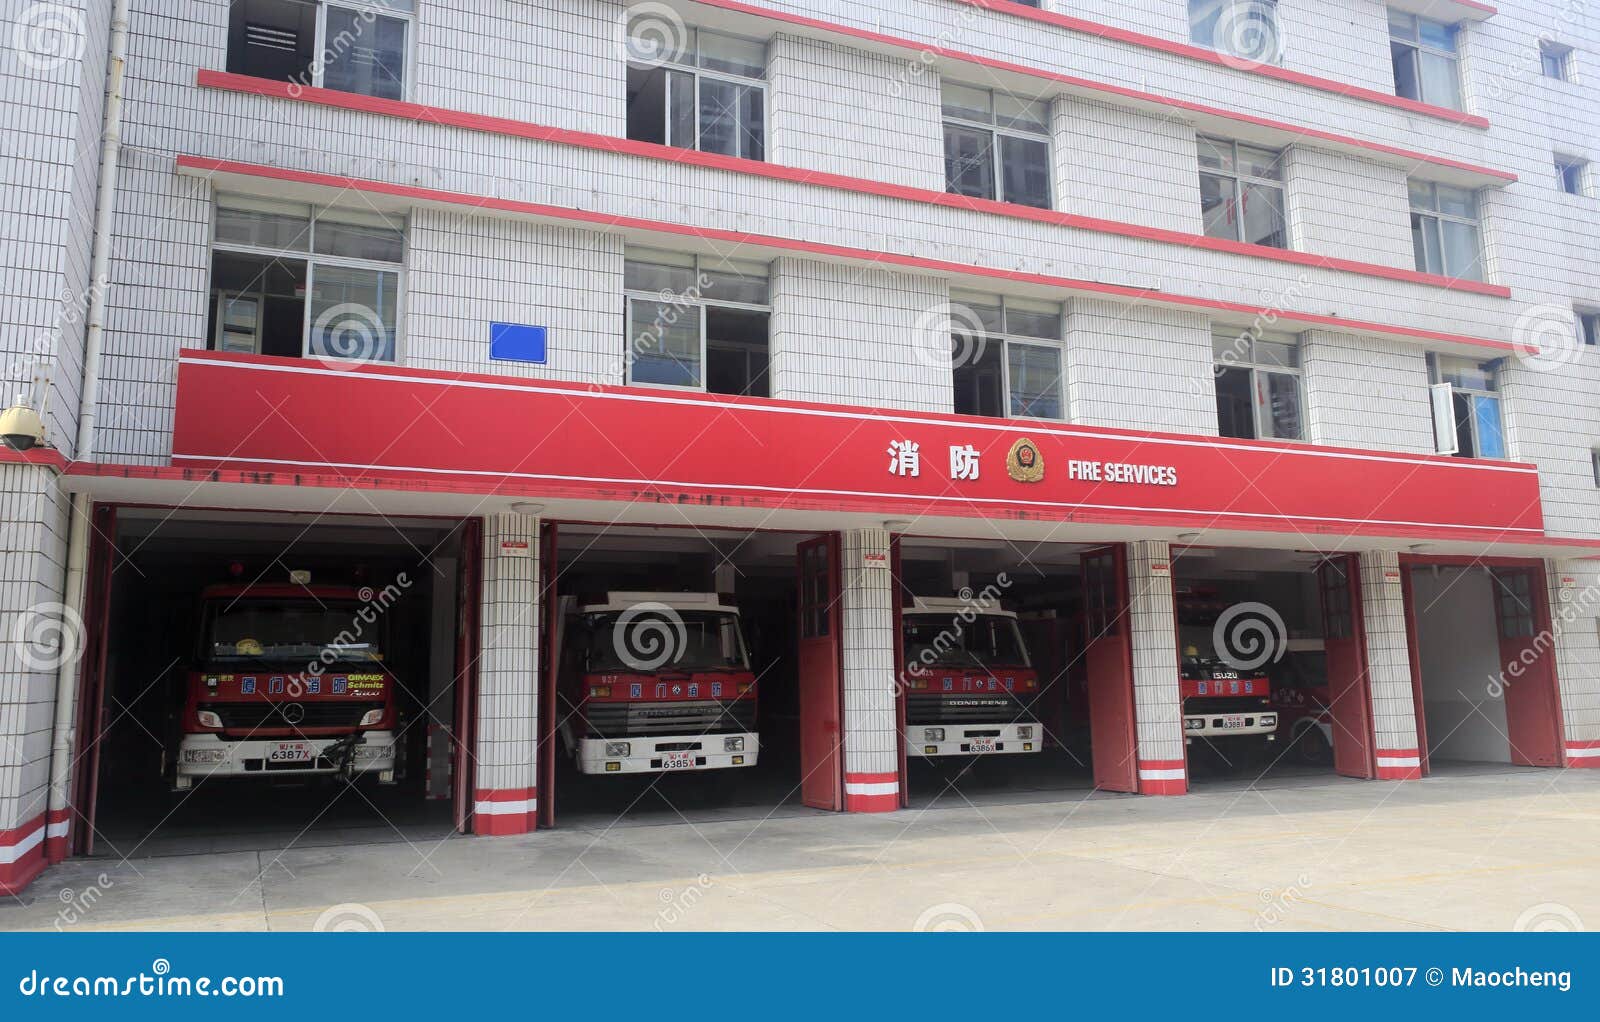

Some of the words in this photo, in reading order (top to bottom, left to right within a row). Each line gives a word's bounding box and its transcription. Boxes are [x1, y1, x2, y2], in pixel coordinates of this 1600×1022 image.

[887, 439, 981, 480] 消防
[1068, 459, 1102, 482] FIRE
[1103, 462, 1178, 486] SERVICES
[1212, 672, 1238, 680] ISUZU
[971, 744, 995, 753] 6386X
[271, 750, 310, 760] 6387X
[663, 759, 695, 769] 6385X
